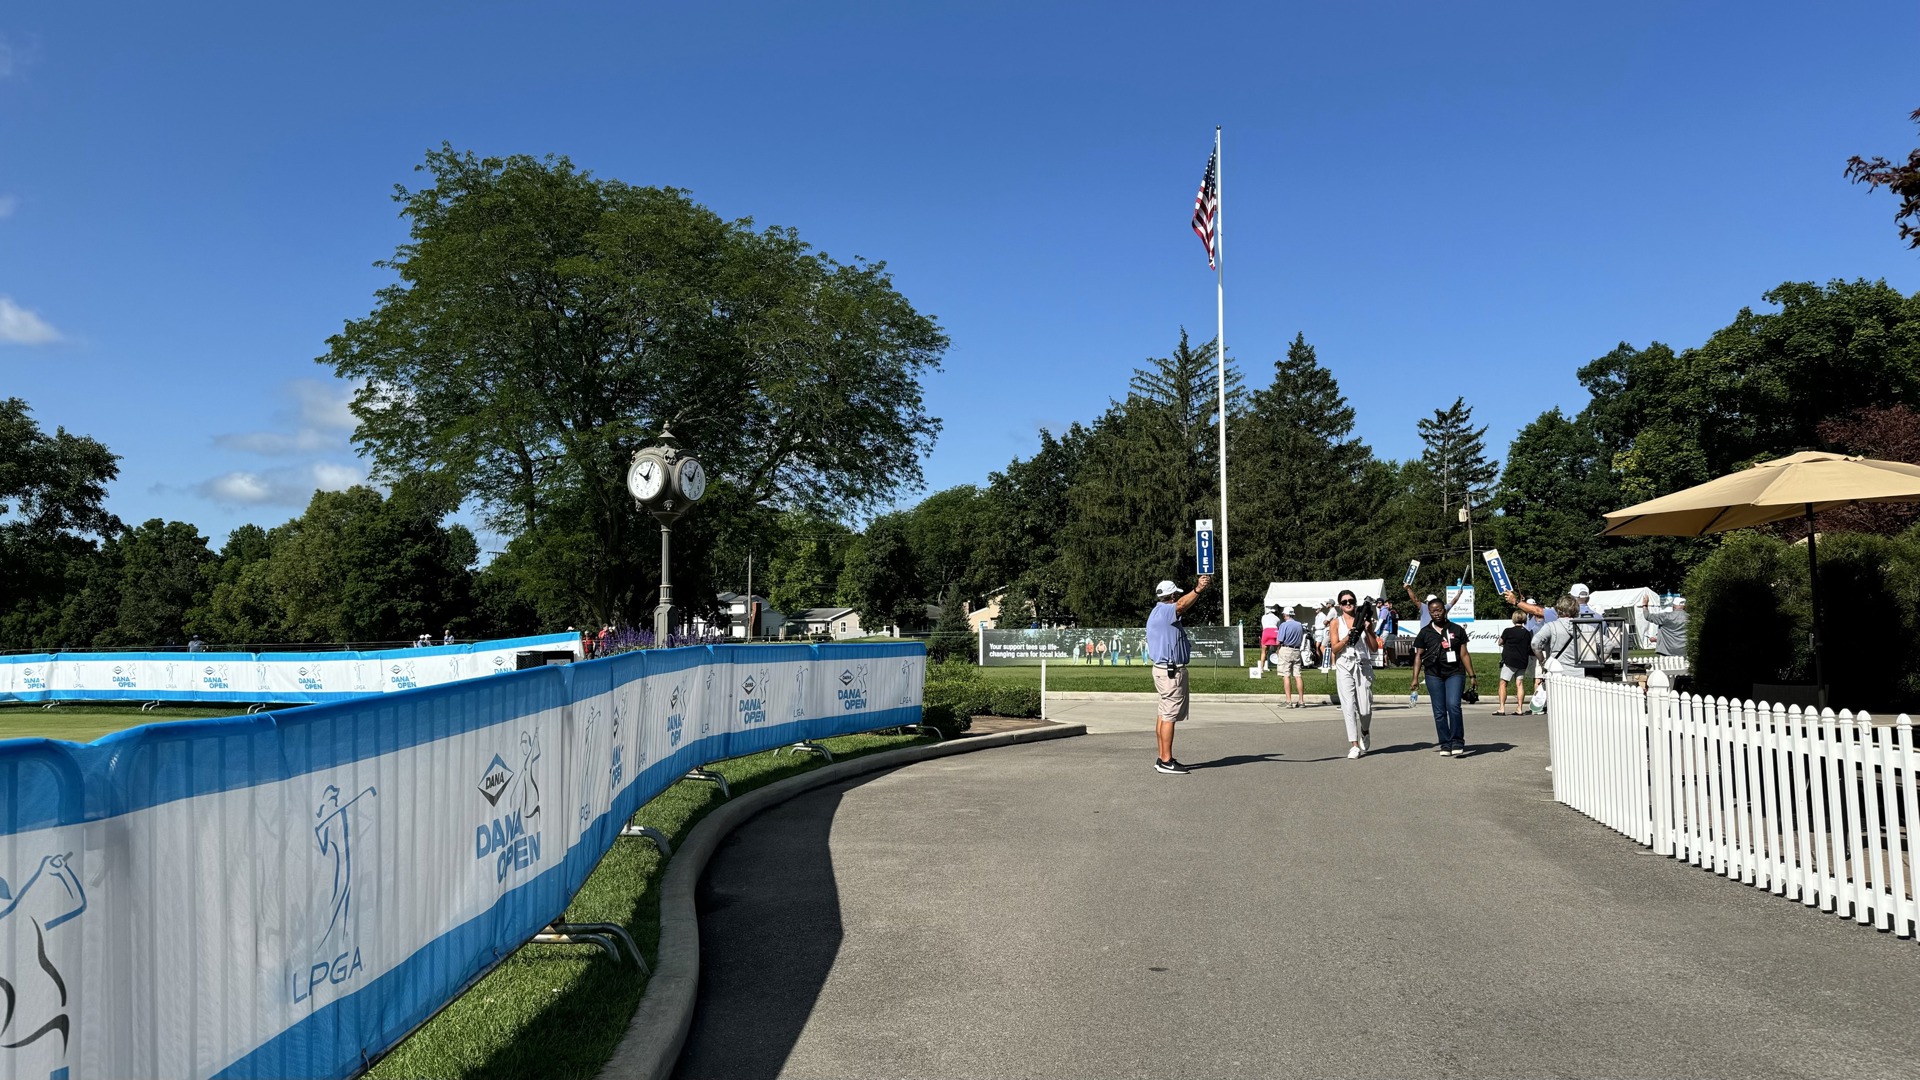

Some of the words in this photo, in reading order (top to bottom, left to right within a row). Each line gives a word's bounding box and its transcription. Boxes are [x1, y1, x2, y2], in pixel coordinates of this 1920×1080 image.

[1200, 531, 1210, 573] QUIET
[1490, 559, 1507, 591] QUIET
[989, 651, 1015, 659] changing
[838, 688, 861, 700] DANA
[739, 699, 761, 712] DANA
[844, 698, 867, 710] OPEN
[744, 710, 766, 725] OPEN
[485, 771, 505, 790] DANA
[476, 807, 525, 860] DANA
[497, 831, 541, 884] OPEN
[293, 946, 363, 1004] LPGA
